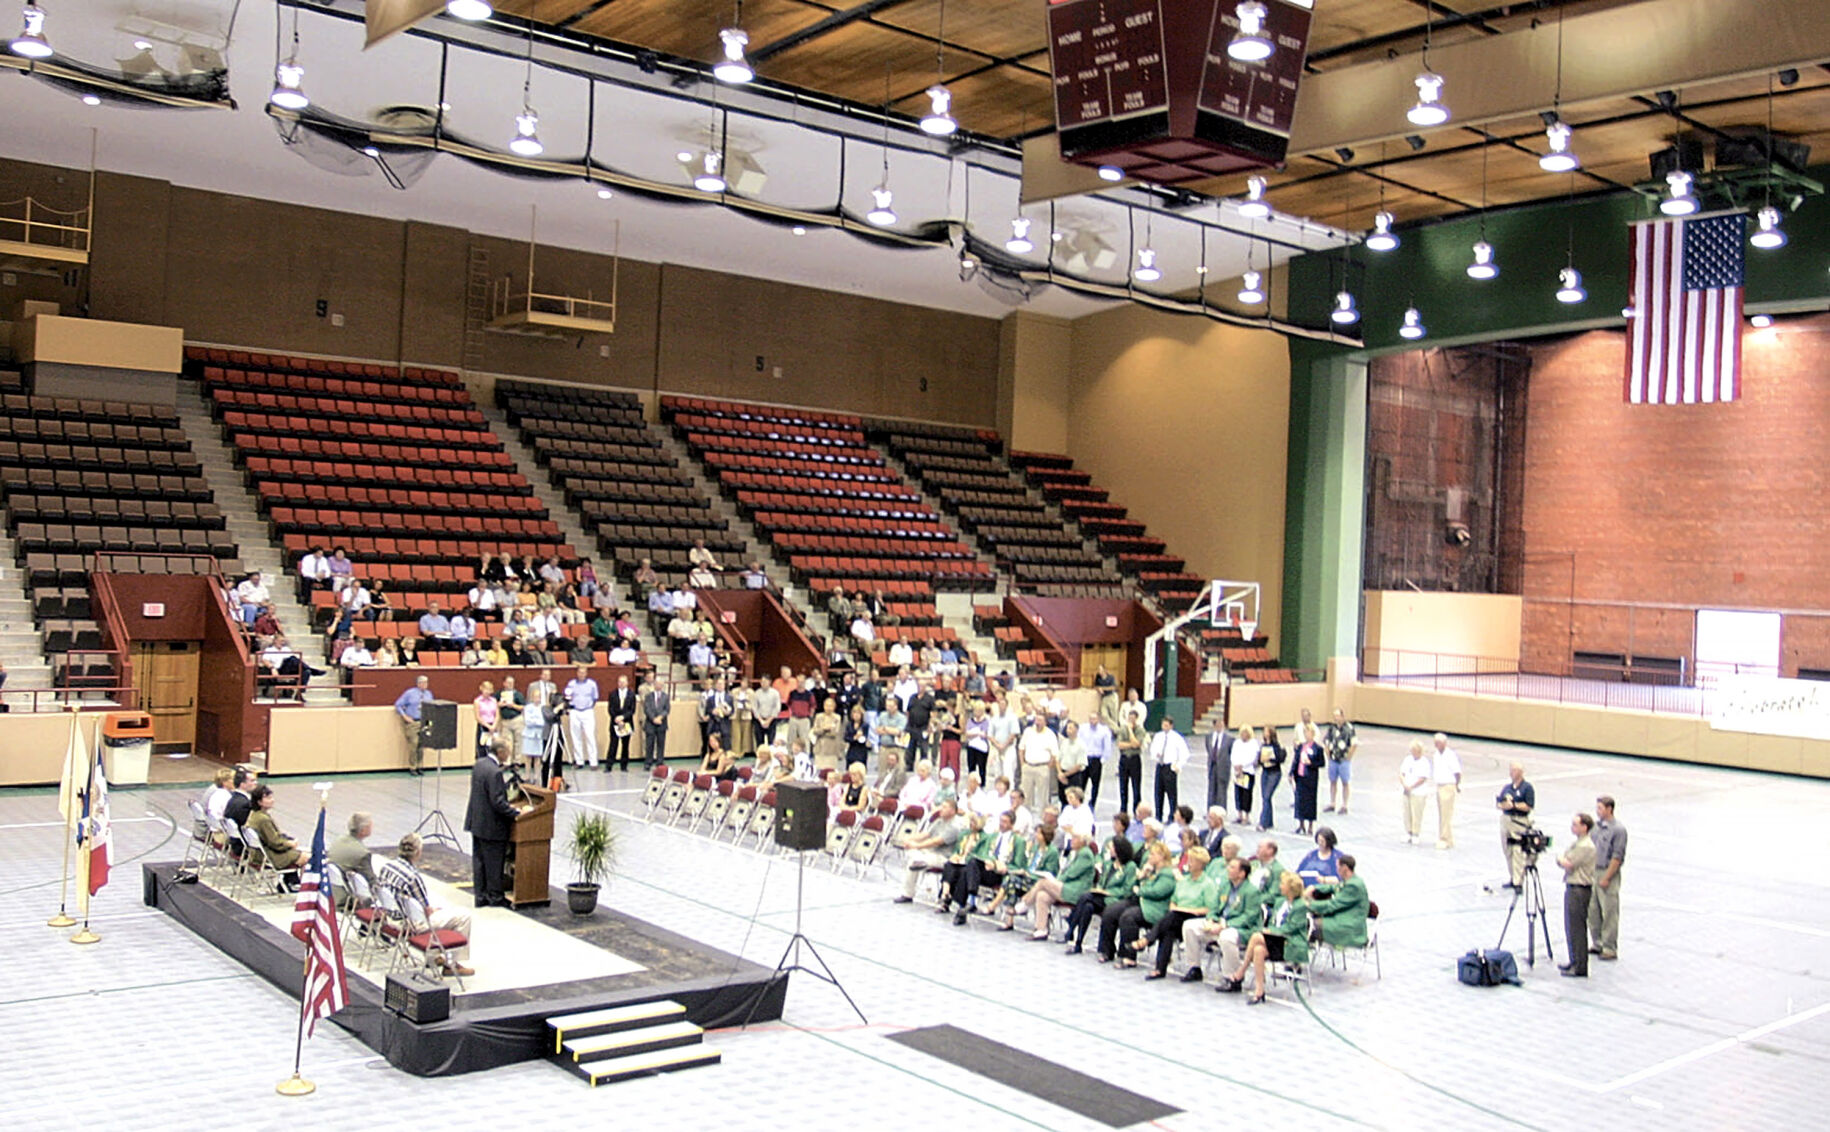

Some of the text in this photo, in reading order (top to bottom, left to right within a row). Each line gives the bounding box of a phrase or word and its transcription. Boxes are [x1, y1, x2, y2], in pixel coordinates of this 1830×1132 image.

[1124, 10, 1153, 28] GUEST
[1058, 30, 1082, 47] HOME
[756, 356, 764, 372] 5
